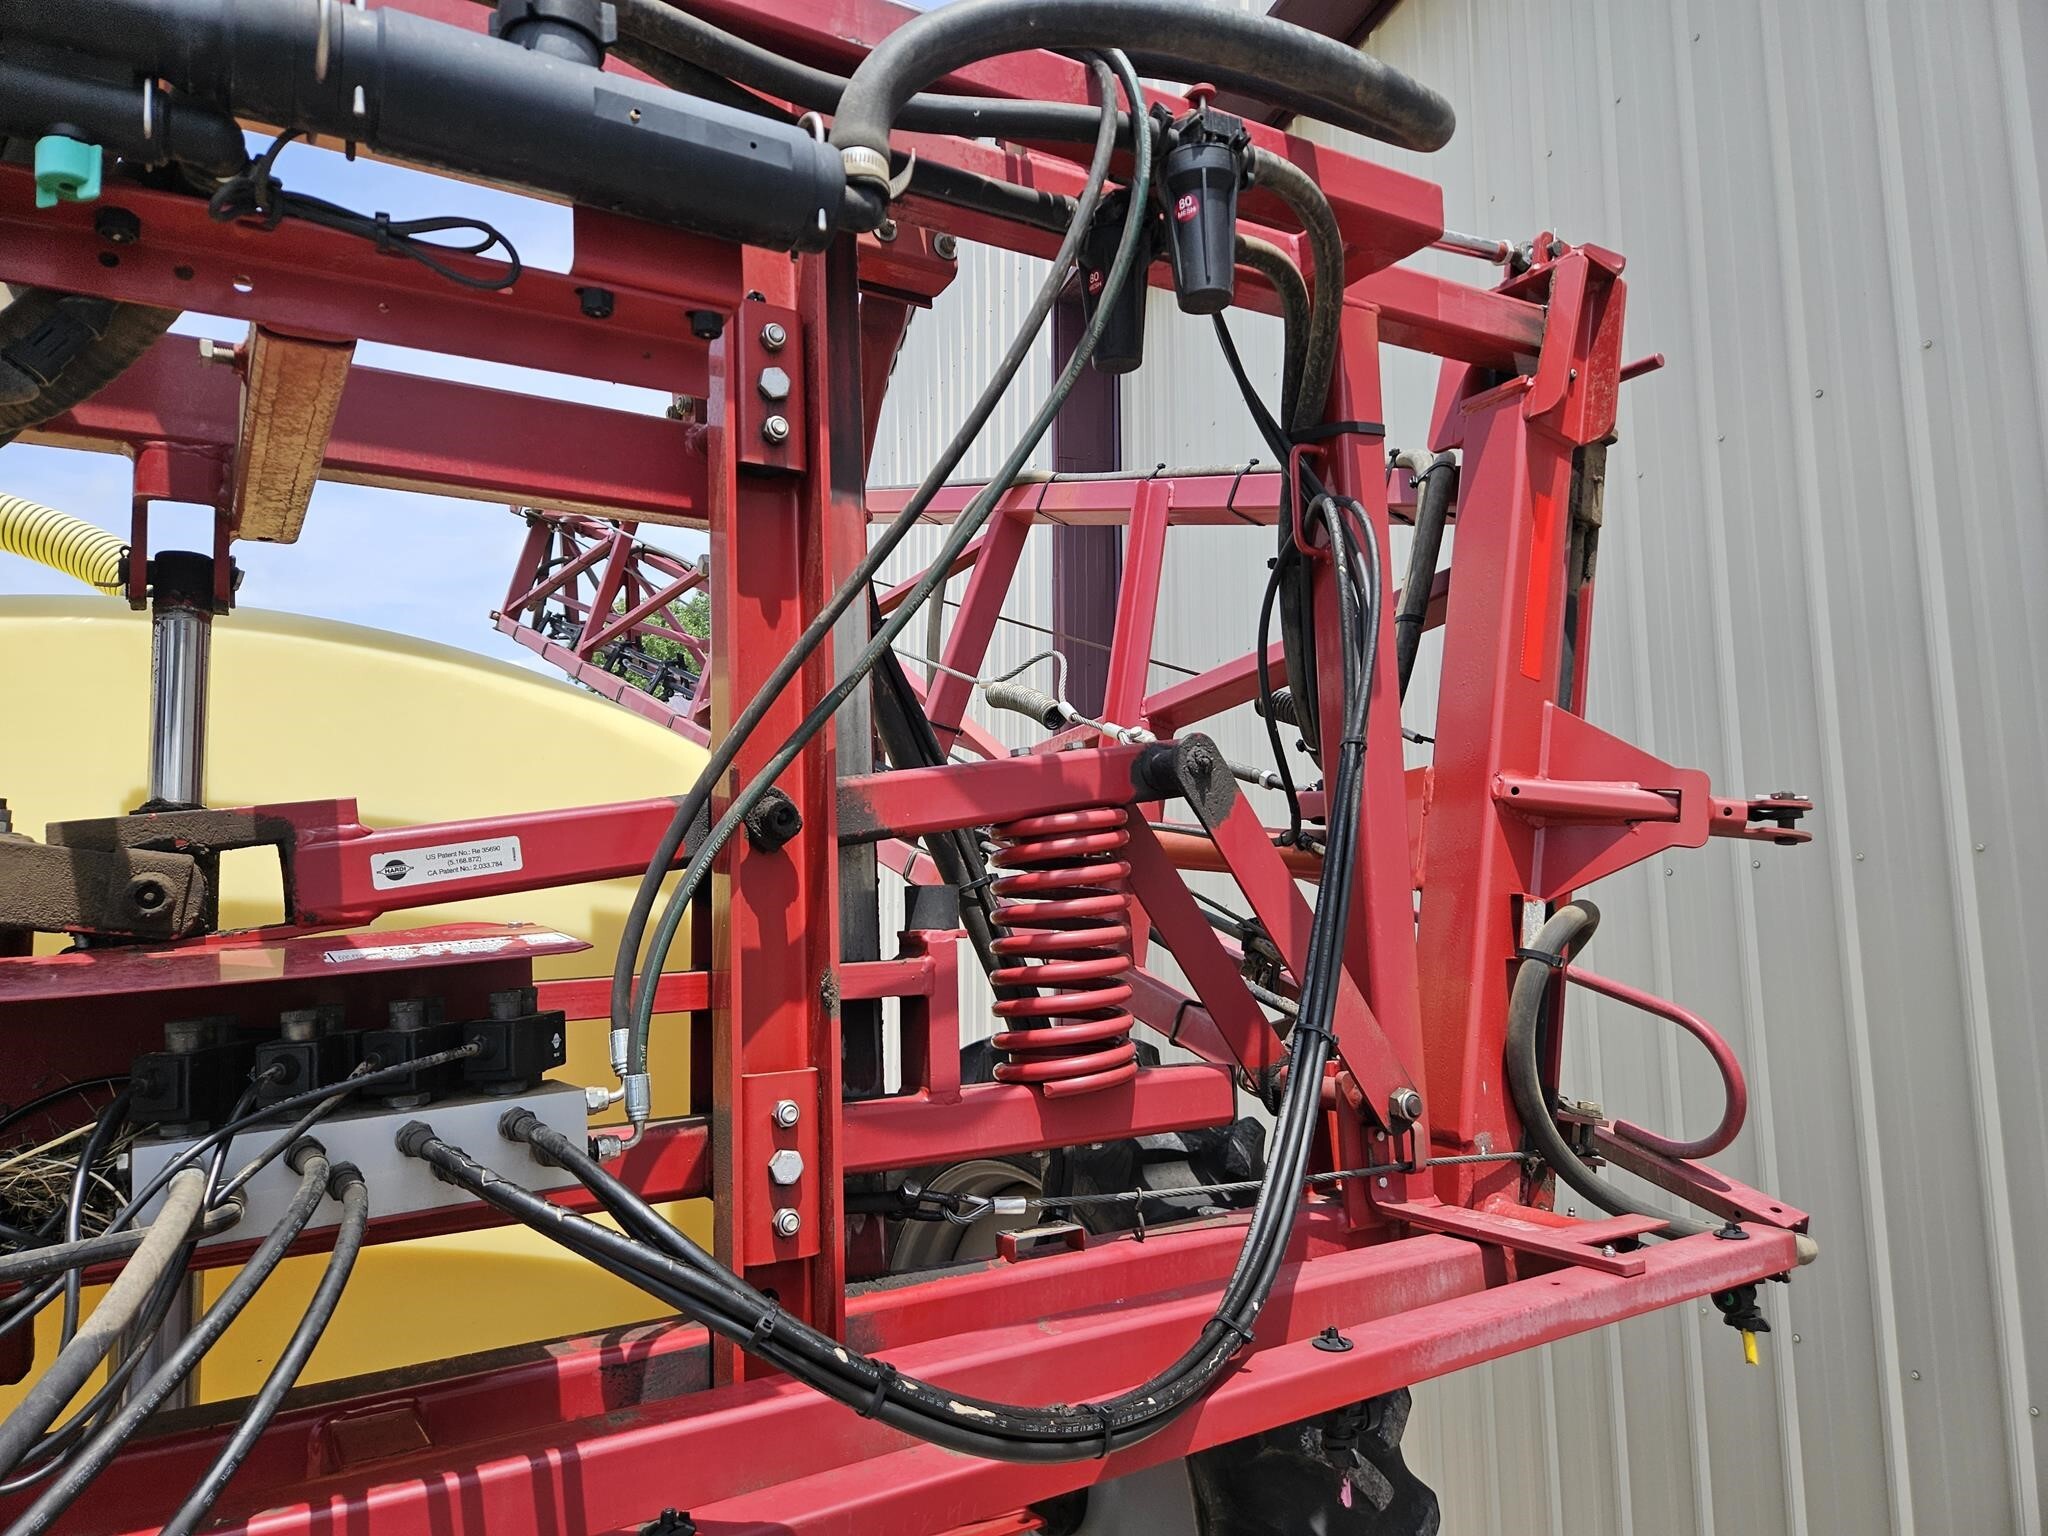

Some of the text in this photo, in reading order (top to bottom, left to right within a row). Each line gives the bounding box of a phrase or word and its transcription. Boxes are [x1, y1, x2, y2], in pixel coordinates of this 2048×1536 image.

[1178, 195, 1192, 210] 80
[1177, 206, 1197, 219] MESH
[1089, 271, 1100, 283] 80
[838, 635, 890, 699] Weatherhead
[425, 853, 436, 861] US
[437, 850, 458, 860] Patent
[482, 845, 501, 854] 35690
[701, 850, 715, 870] BAR
[712, 828, 731, 853] (6500
[384, 866, 407, 874] HARDI
[427, 869, 438, 877] CA
[438, 866, 459, 875] Patent
